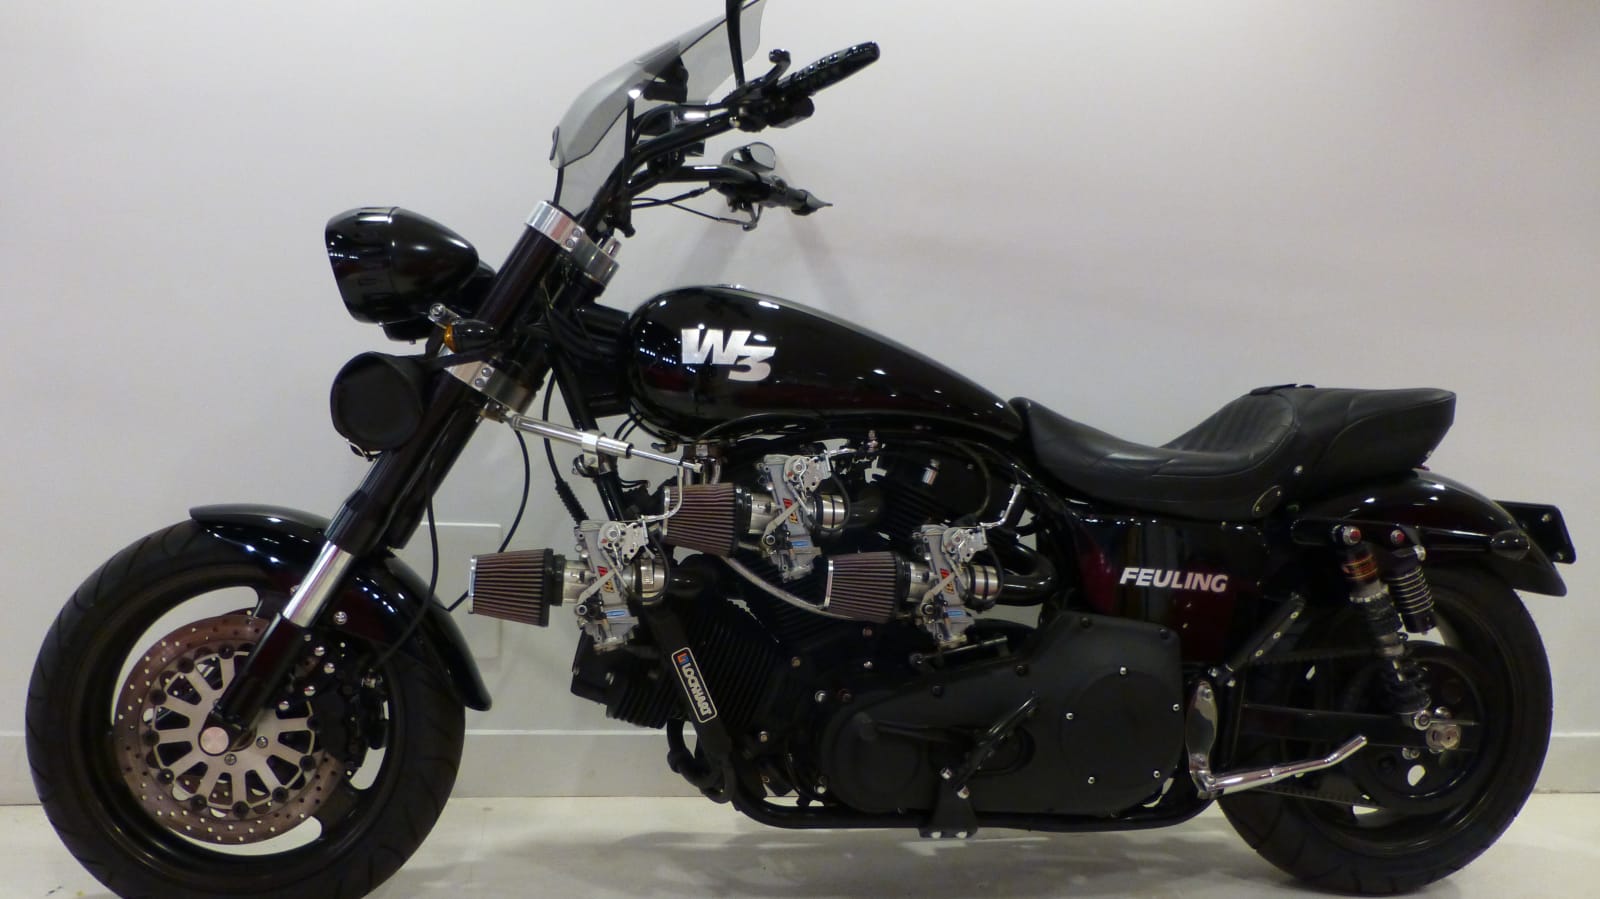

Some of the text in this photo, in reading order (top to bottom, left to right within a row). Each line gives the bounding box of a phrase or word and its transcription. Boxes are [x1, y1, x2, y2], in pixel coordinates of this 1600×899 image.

[681, 328, 776, 381] W3
[1119, 567, 1228, 593] FEULING
[681, 662, 712, 716] LOCKHART
